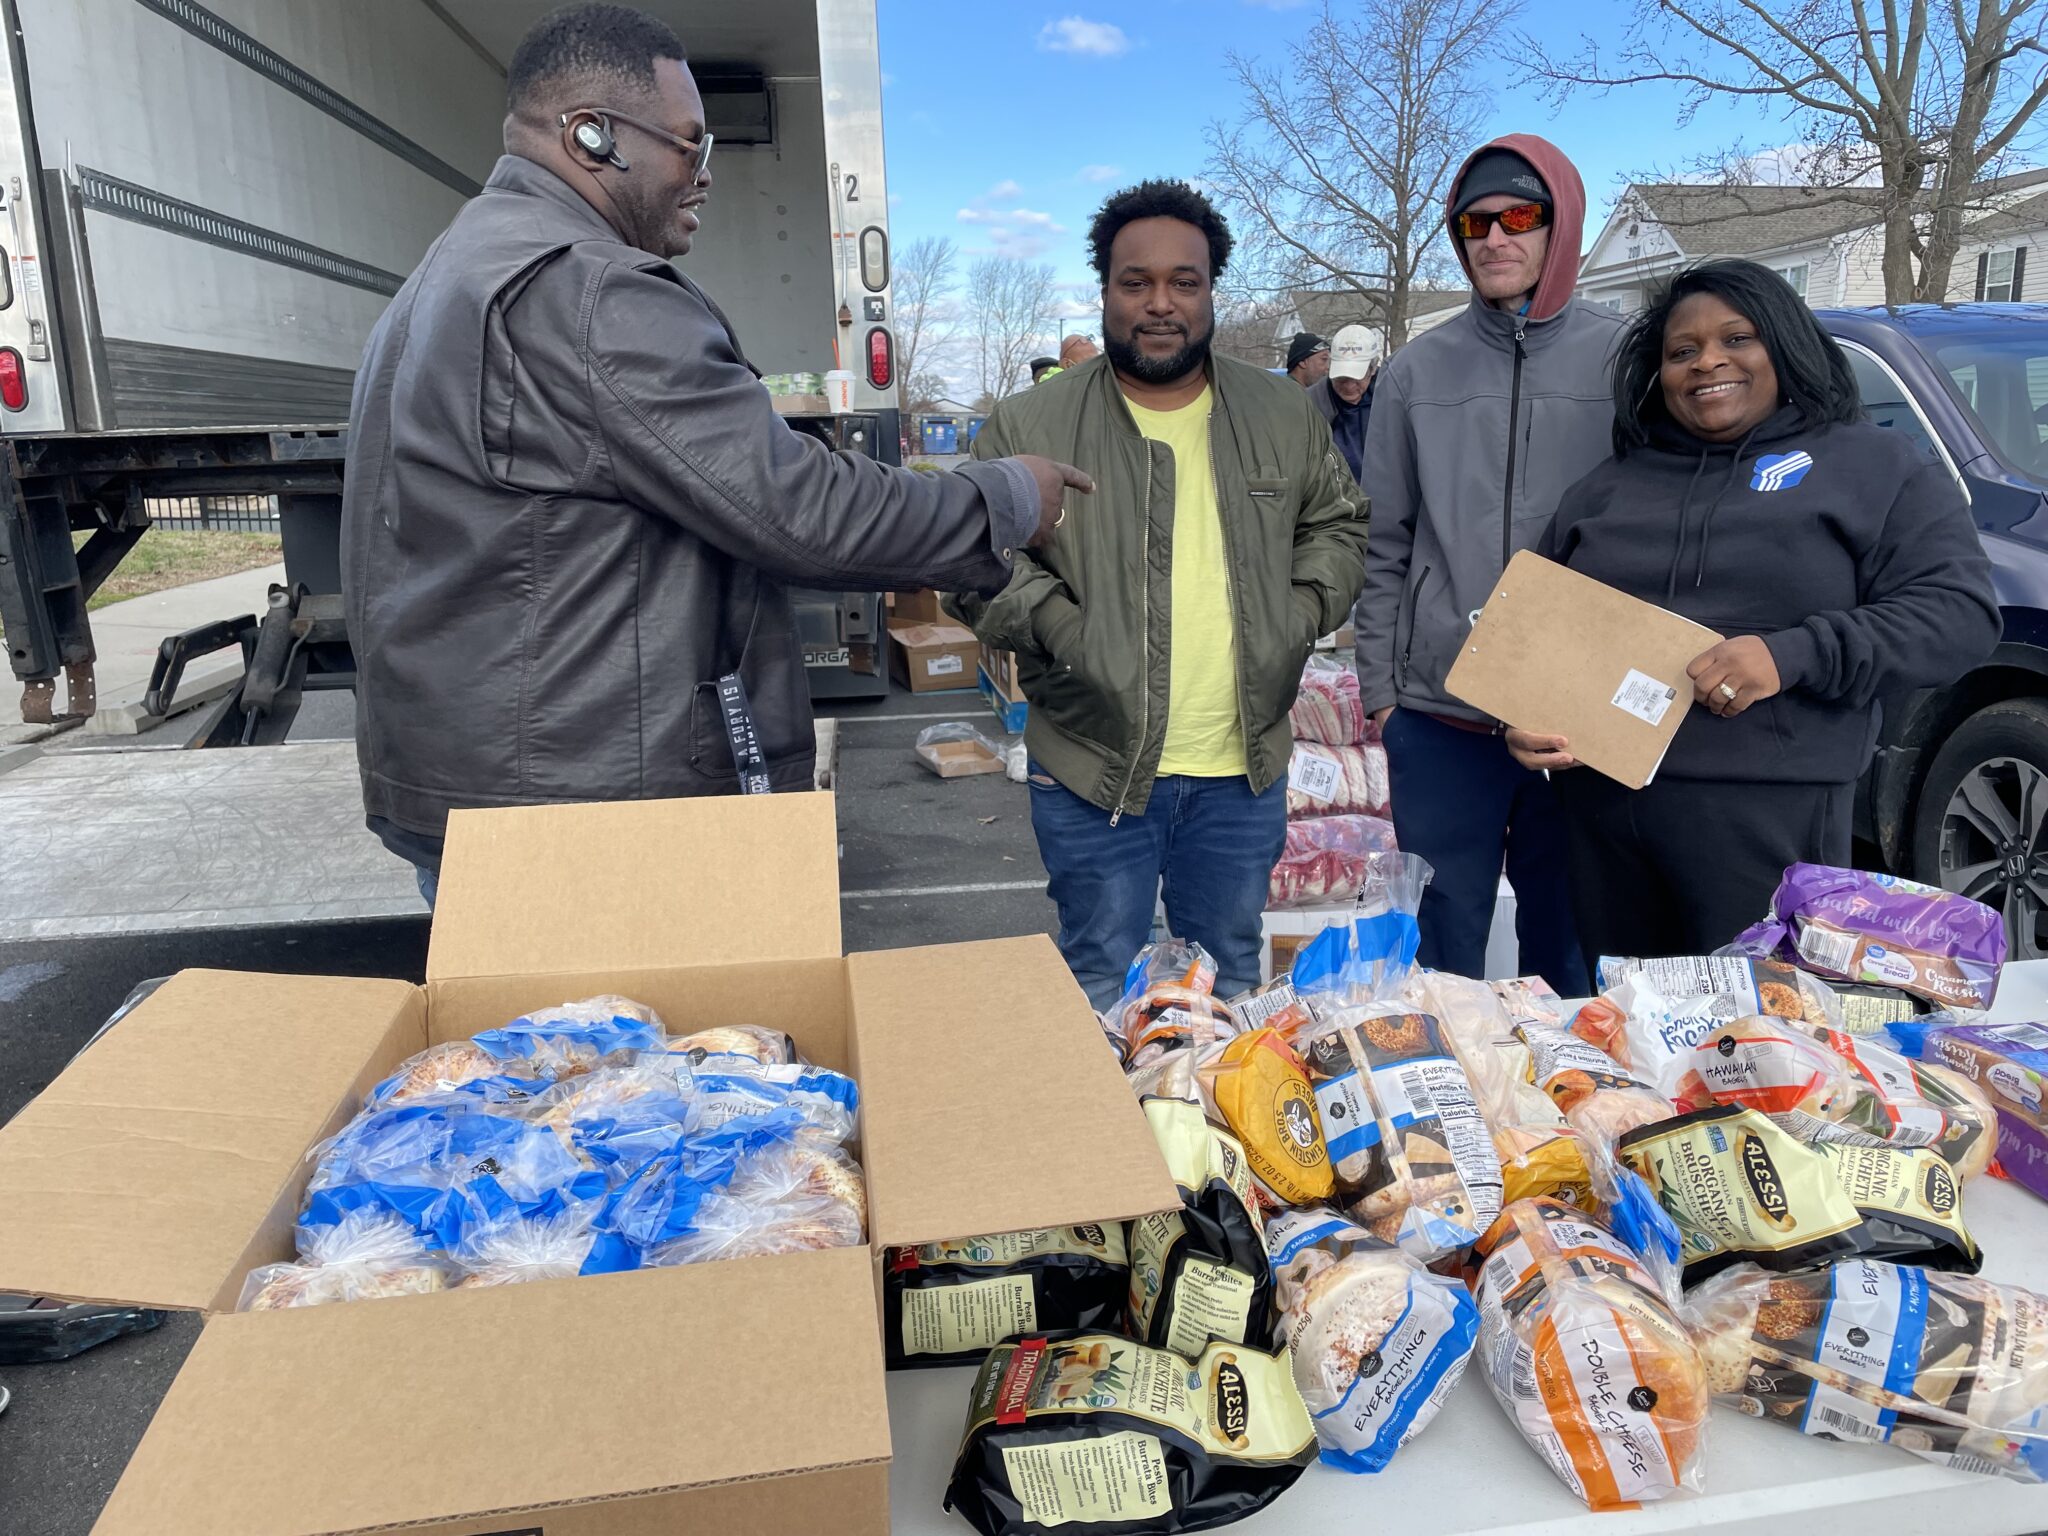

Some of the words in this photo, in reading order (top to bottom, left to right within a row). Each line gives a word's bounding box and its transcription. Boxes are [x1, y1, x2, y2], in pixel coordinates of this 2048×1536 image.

[846, 174, 859, 201] 2
[804, 651, 849, 663] ORGA
[723, 686, 739, 701] IS
[728, 708, 746, 743] FURY
[738, 748, 748, 756] A
[1883, 915, 1924, 936] with
[1928, 919, 1963, 944] Love
[1701, 978, 1710, 994] 230
[1883, 968, 1910, 980] Bread
[1924, 968, 1978, 986] Cinnamon
[1933, 980, 1984, 1000] Raisin
[1706, 1061, 1758, 1079] HAWAIIAN
[1721, 1076, 1748, 1085] BAGELS
[1993, 1068, 2020, 1086] Bread
[1293, 1082, 1318, 1112] BAGELS
[1275, 1109, 1291, 1144] BROS
[1289, 1143, 1324, 1165] EINSTEIN
[1675, 1151, 1687, 1177] OVEN
[1683, 1179, 1697, 1210] BAKED
[1718, 1169, 1733, 1205] ITALIAN
[1736, 1160, 1756, 1204] AUTENTICO
[1746, 1142, 1787, 1213] ALESSI
[1872, 1148, 1891, 1198] ORGANIC
[1891, 1160, 1901, 1189] ITALIAN
[1933, 1166, 1952, 1209] ALESSI
[1681, 1141, 1736, 1241] BRUSCHETTE
[1697, 1154, 1733, 1228] ORGANIC
[1291, 1233, 1317, 1249] BAGELS
[1014, 1285, 1026, 1317] Burrata
[1024, 1301, 1033, 1323] Pesto
[1017, 1319, 1026, 1335] Bite
[1297, 1311, 1313, 1339] (425g)
[1824, 1341, 1886, 1367] EVERYTHING
[2013, 1338, 2027, 1352] WT
[1581, 1339, 1616, 1406] DOUBLE
[1840, 1355, 1866, 1368] BAGELS
[2009, 1351, 2024, 1369] NET
[1006, 1350, 1039, 1413] TRADITIONAL
[1139, 1382, 1149, 1404] TOASTS
[1150, 1353, 1171, 1414] BRUSCHETTE
[1354, 1329, 1427, 1432] EVERYTHING
[1381, 1402, 1404, 1435] AUTHENTIC
[1403, 1373, 1426, 1401] GOURMET
[1424, 1347, 1442, 1371] BAGELS
[1384, 1368, 1413, 1405] BAGELS
[1221, 1370, 1245, 1435] ALESSI
[1588, 1394, 1611, 1434] BAGELS
[1607, 1411, 1647, 1478] CHEESE
[1137, 1440, 1153, 1481] Burrata
[1147, 1483, 1158, 1505] Bites
[1151, 1458, 1162, 1485] Pesto
